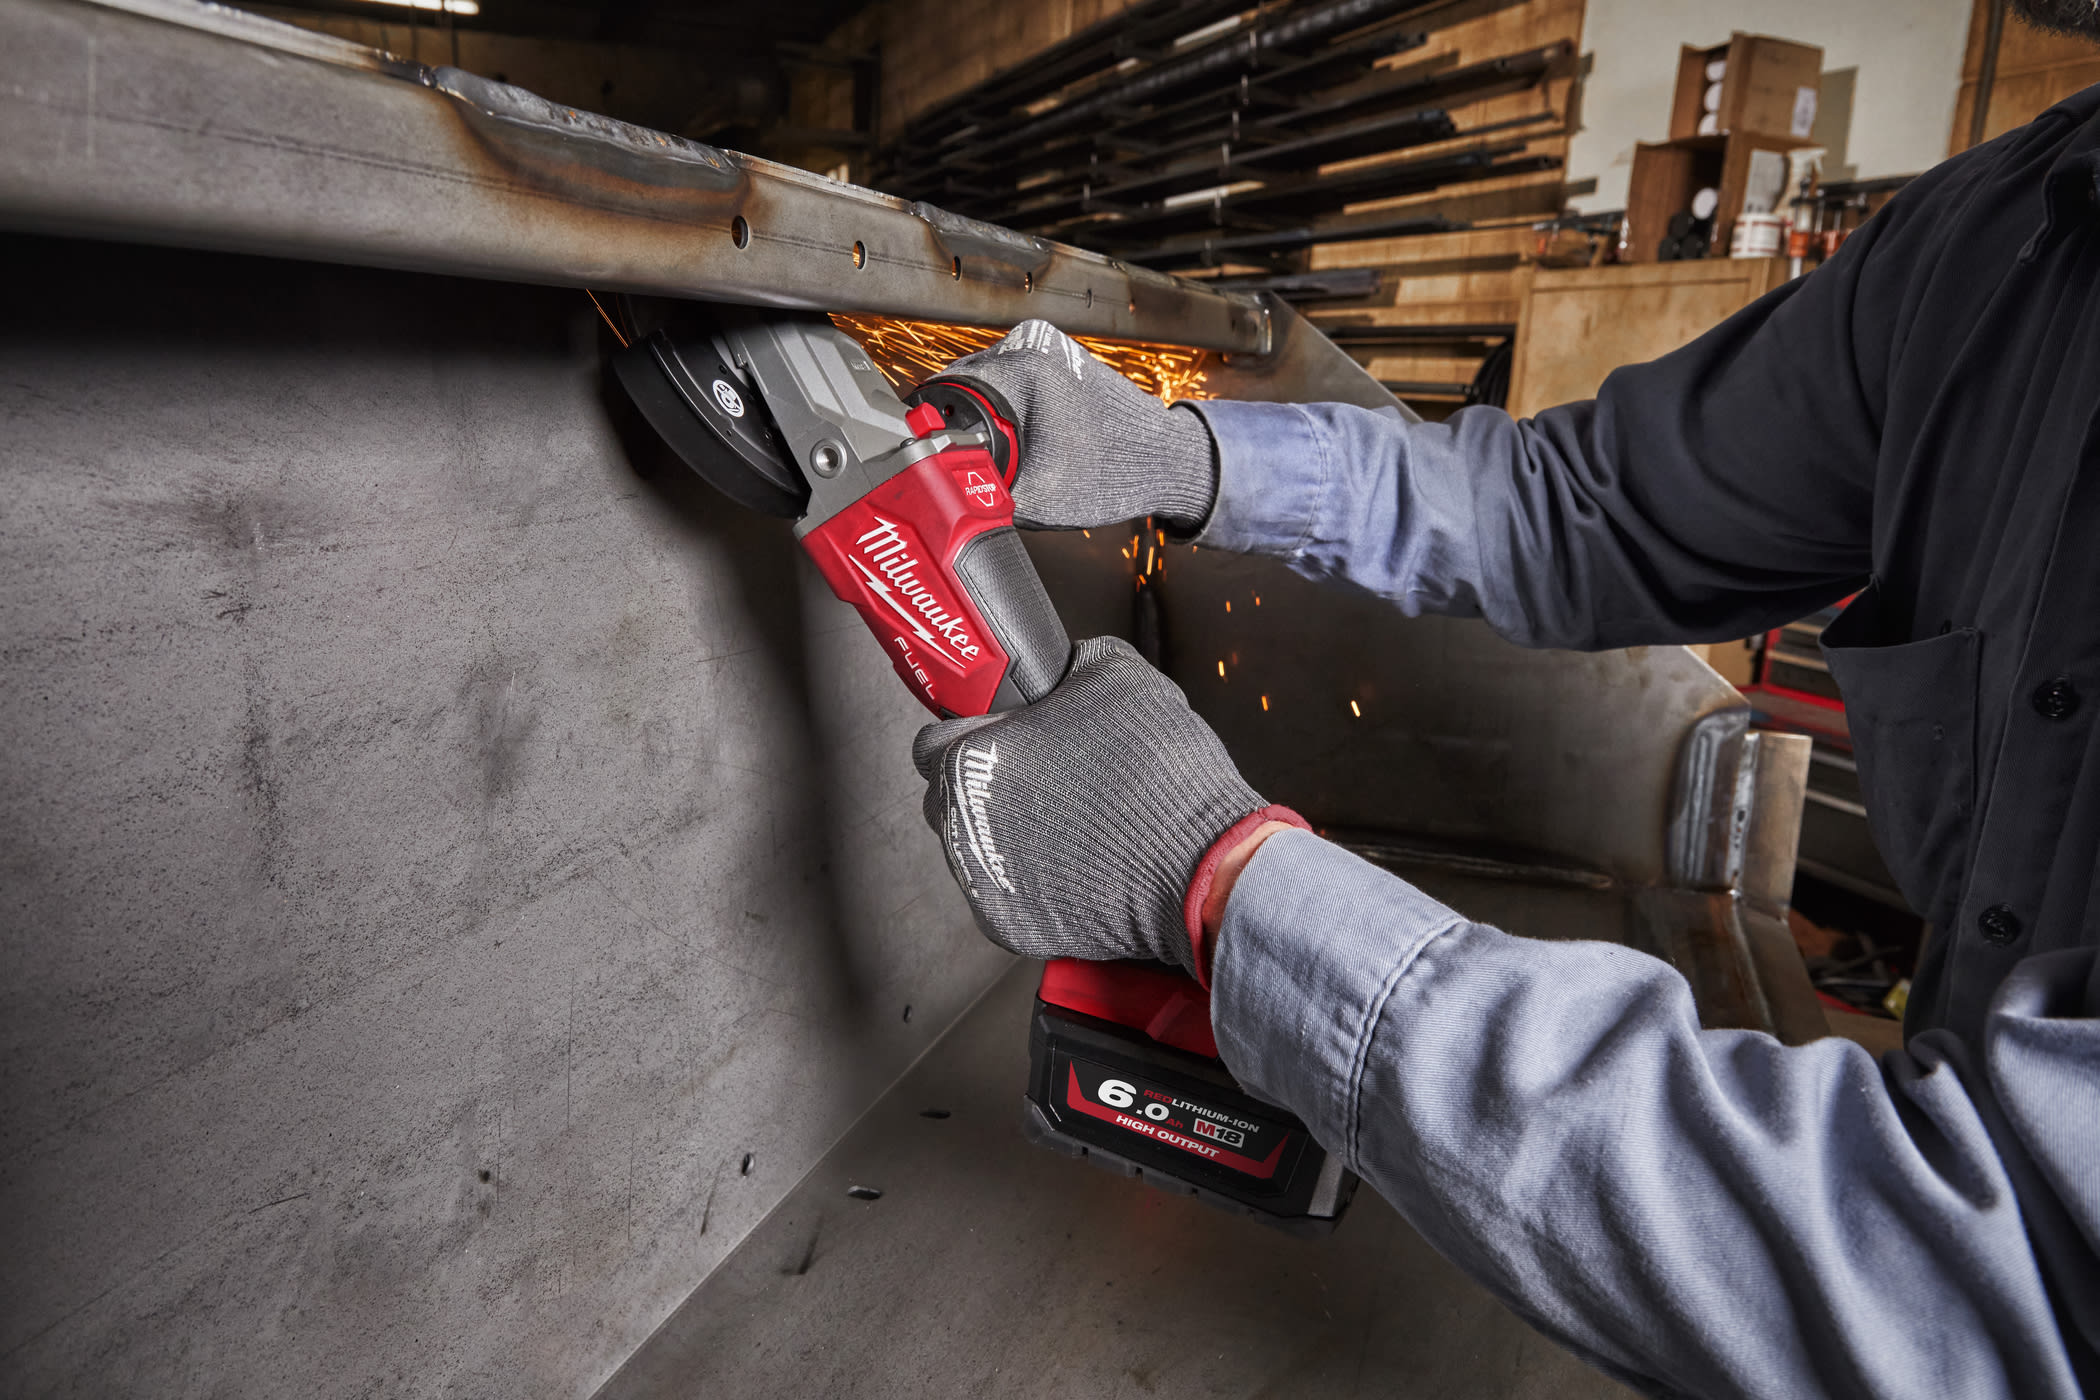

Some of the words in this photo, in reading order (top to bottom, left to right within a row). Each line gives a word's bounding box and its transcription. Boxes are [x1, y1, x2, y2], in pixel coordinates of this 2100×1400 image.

[965, 483, 996, 496] RAPIDSTOP
[856, 516, 980, 662] Milwaukee
[894, 636, 936, 700] FUEL
[964, 741, 1016, 894] Milwaukee
[1097, 1079, 1170, 1122] 6.0
[1115, 1114, 1155, 1136] HIGH
[1156, 1129, 1221, 1159] OUTPUT
[1195, 1120, 1244, 1146] M18
